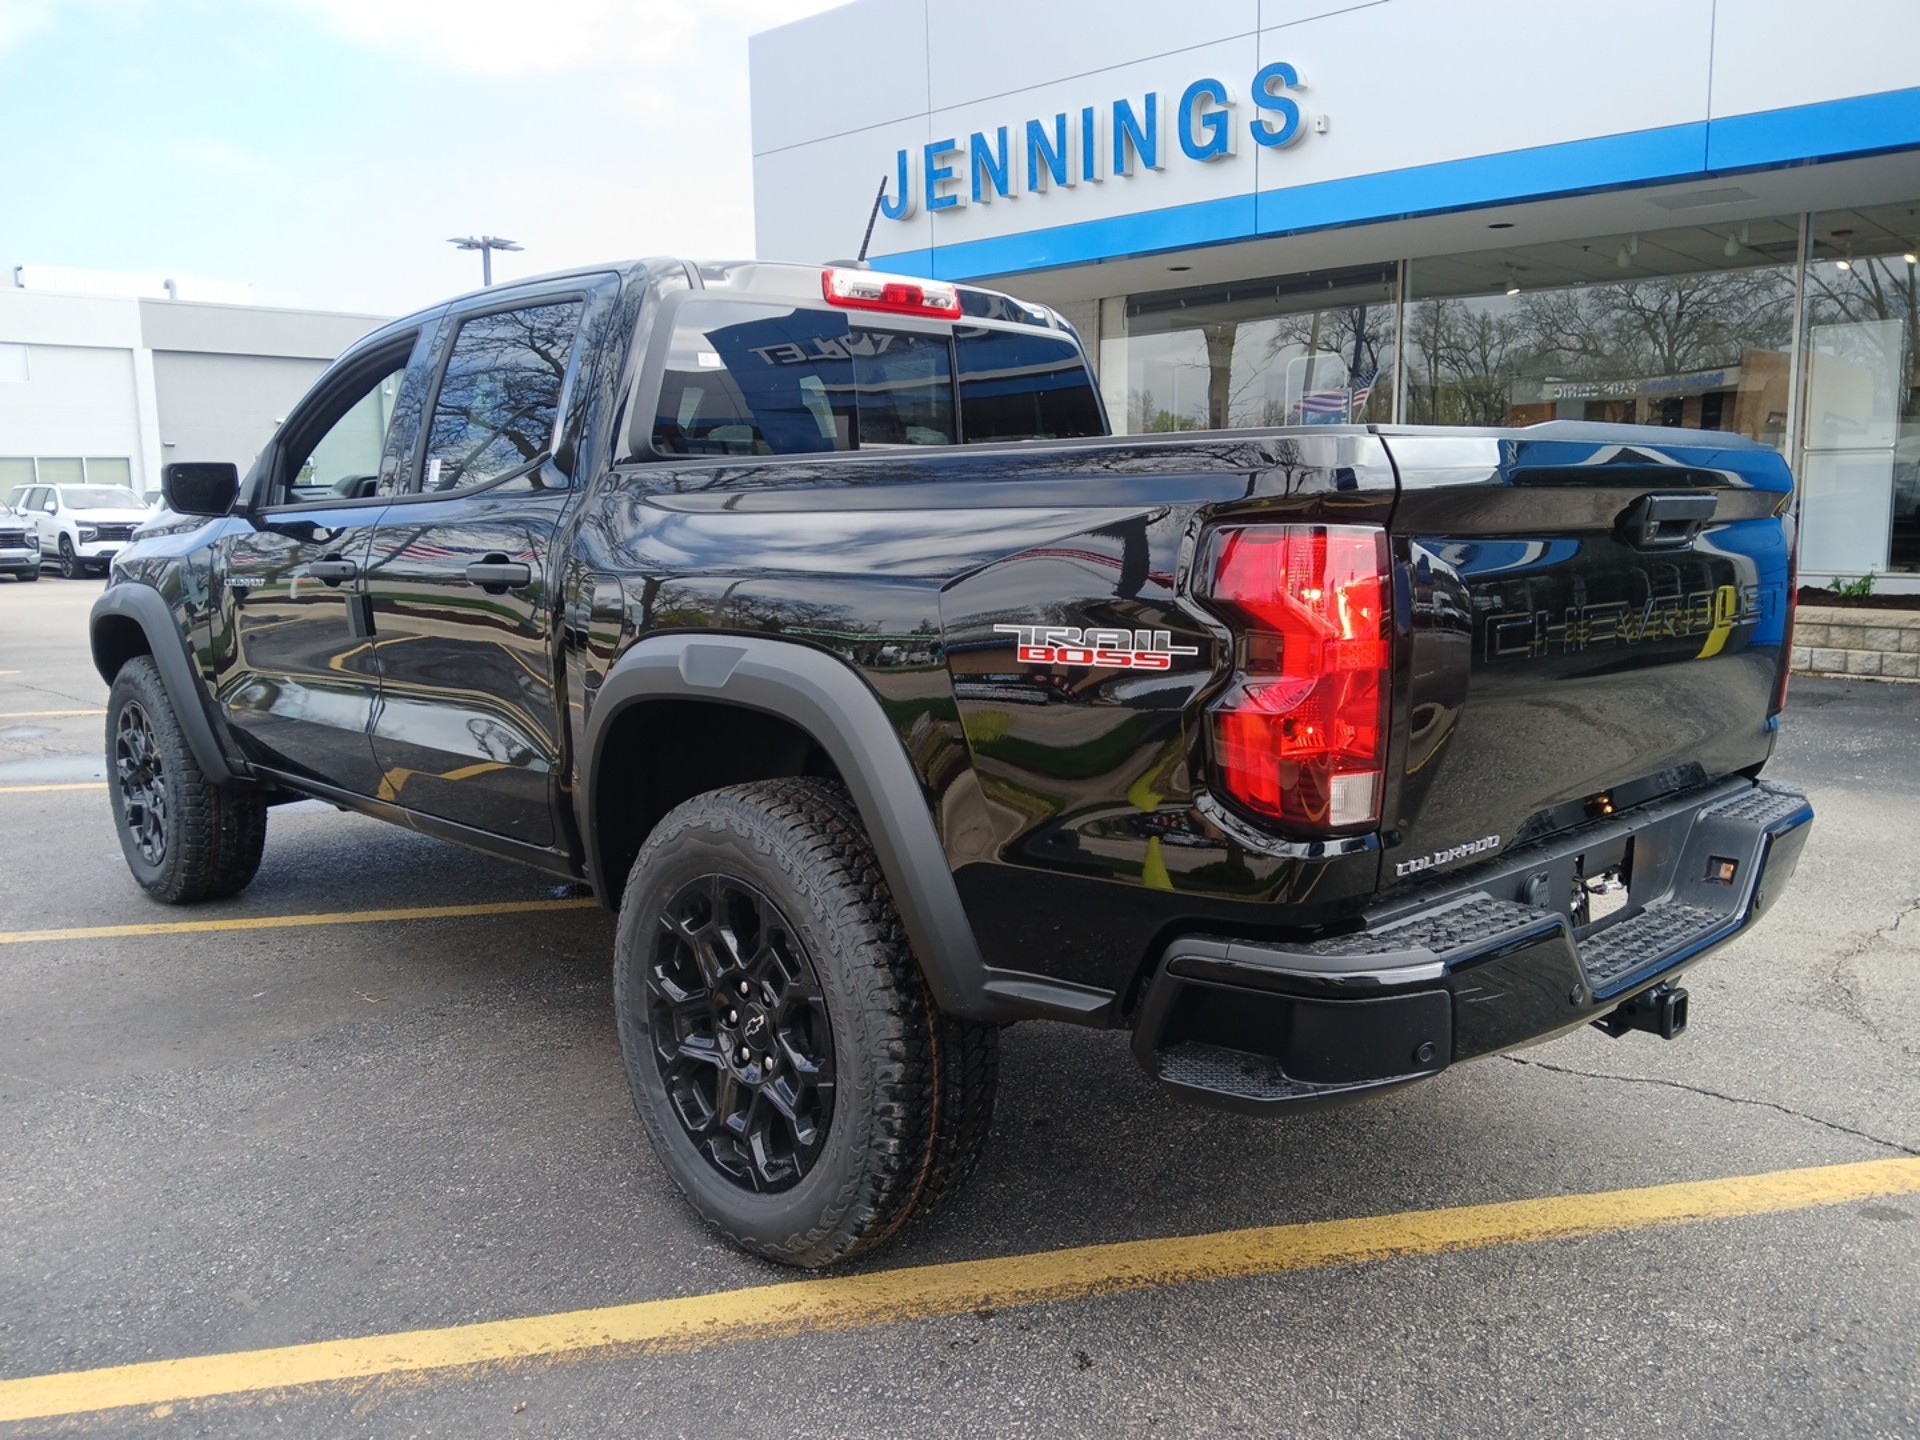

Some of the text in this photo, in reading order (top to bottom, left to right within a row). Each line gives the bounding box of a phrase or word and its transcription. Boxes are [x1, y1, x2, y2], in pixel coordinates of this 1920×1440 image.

[881, 62, 1305, 221] JENNINGS
[993, 623, 1198, 656] TRAIL
[1484, 581, 1784, 663] CHEVROLET
[1017, 646, 1171, 671] BOSS
[1396, 834, 1500, 877] COLORADO
